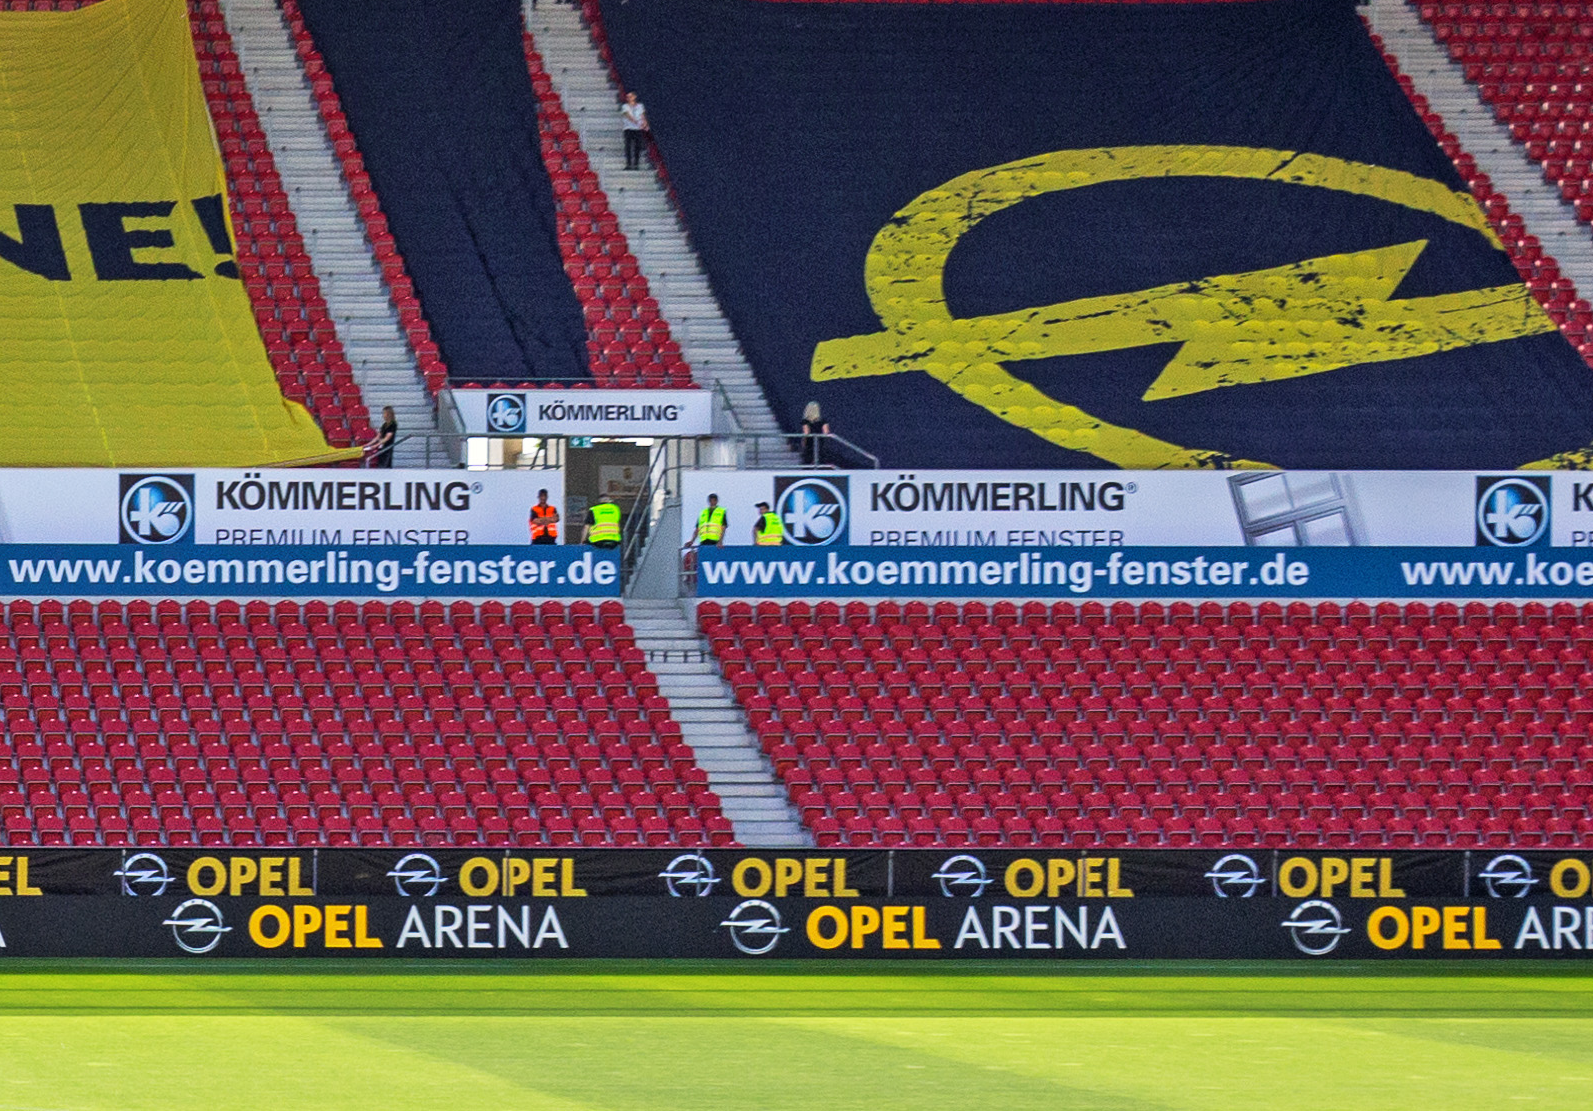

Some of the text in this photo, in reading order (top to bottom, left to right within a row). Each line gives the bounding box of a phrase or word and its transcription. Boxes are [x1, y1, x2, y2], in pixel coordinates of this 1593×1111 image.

[9, 551, 615, 591] www.koemmerling-fenster.de
[703, 552, 1308, 592] www.koemmerling-fenster.de
[186, 856, 314, 897] OPEL
[459, 856, 587, 897] OPEL
[732, 857, 860, 898] OPEL
[1004, 857, 1134, 898] OPEL
[1279, 856, 1406, 898] OPEL
[249, 905, 569, 948] OPEL ARENA
[806, 906, 1126, 949] OPEL ARENA
[1368, 906, 1501, 949] OPEL
